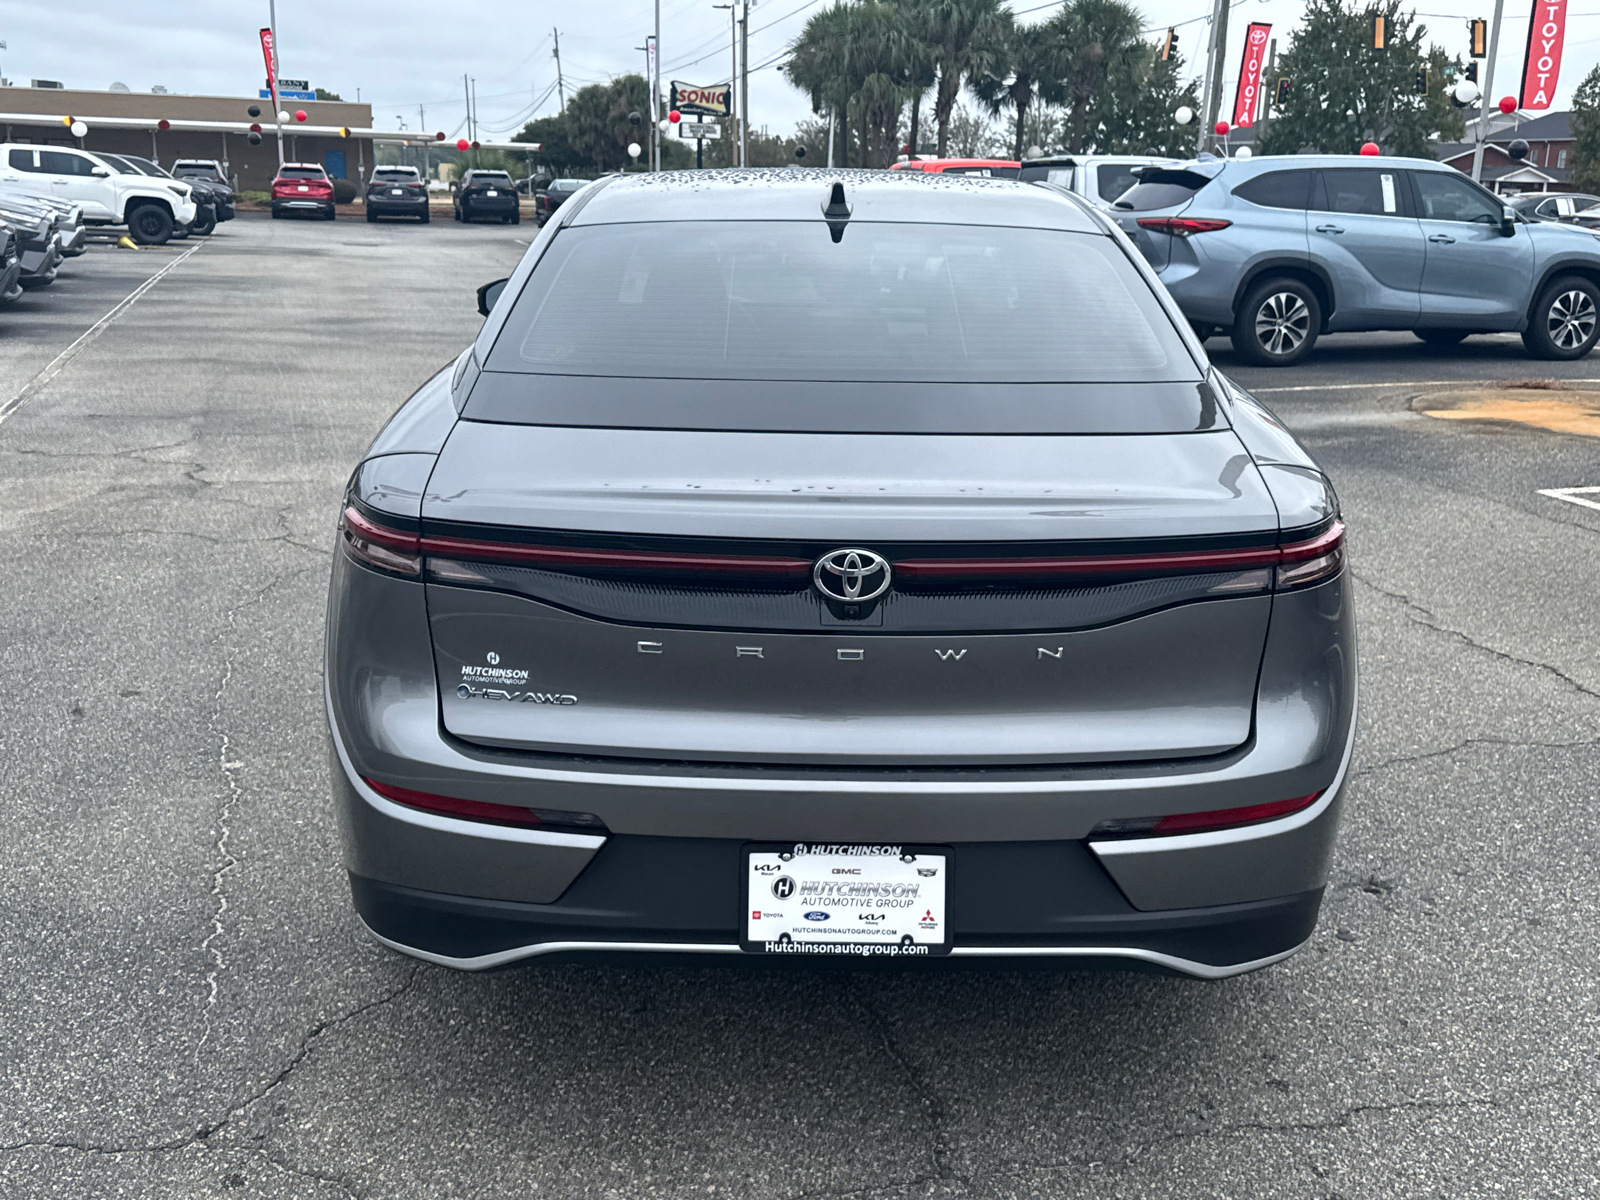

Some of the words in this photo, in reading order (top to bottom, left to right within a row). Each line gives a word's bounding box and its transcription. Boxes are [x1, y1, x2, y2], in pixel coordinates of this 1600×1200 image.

[1533, 6, 1559, 104] TOYOTA
[1239, 46, 1258, 123] TOYOTA
[678, 89, 725, 105] SONIC
[637, 641, 1063, 660] CROWN
[461, 666, 529, 679] HUTCHINSON
[463, 675, 503, 683] AUTOMOTIVE
[520, 692, 578, 705] AWD
[810, 845, 902, 857] HUTCHINSON
[799, 881, 919, 898] HUTCHINSON
[801, 897, 873, 908] AUTOMOTIVE
[876, 899, 914, 908] GROUP
[808, 912, 826, 920] Ford
[792, 927, 897, 935] HUTCHINSONAUTOGROUP.COM
[765, 941, 928, 956] Hutchinsonautogroup.com
